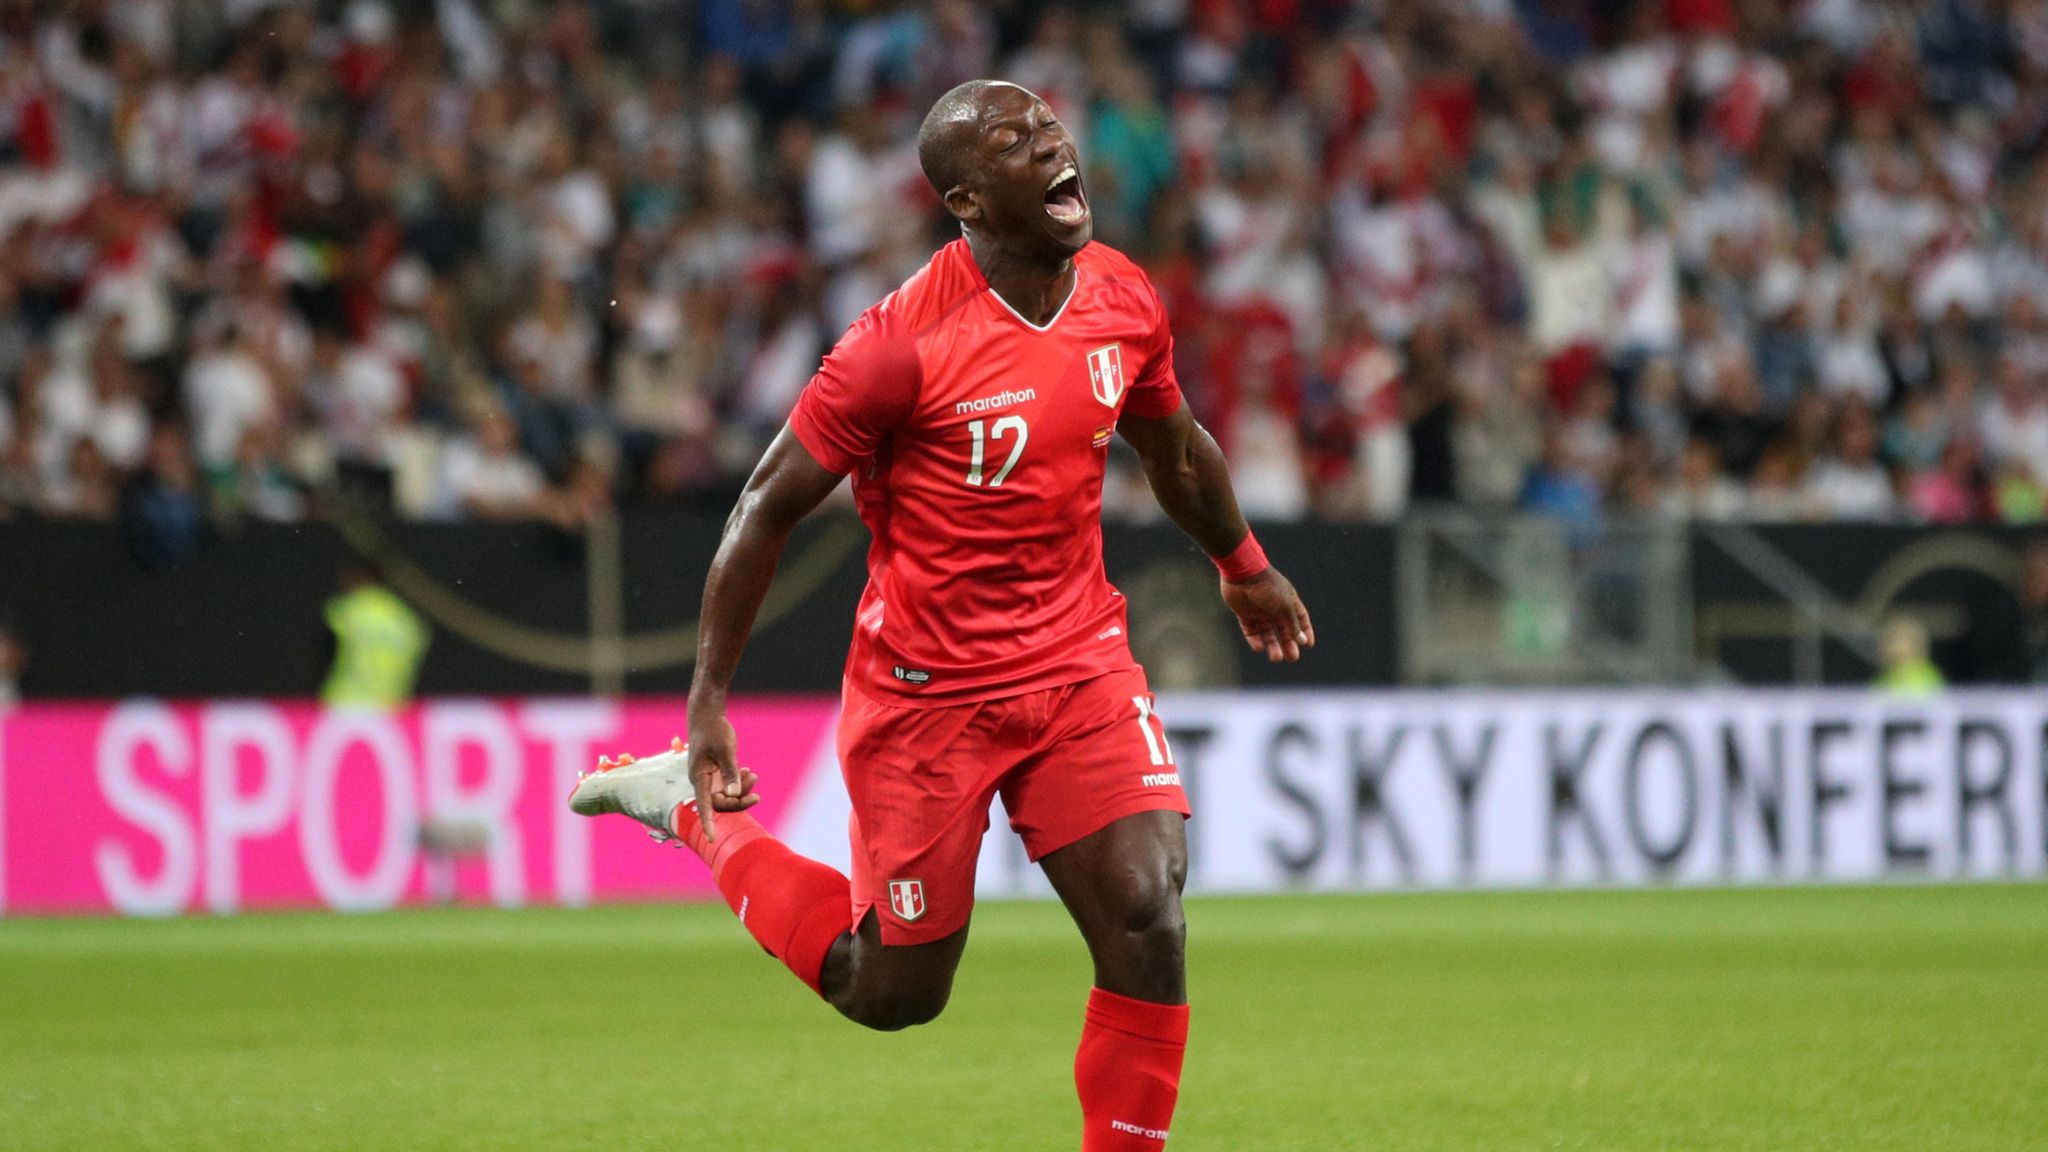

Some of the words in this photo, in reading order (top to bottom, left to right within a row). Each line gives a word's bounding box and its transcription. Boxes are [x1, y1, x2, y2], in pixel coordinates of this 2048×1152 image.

[956, 388, 1036, 415] marathon
[96, 700, 617, 915] SPORT
[1264, 720, 1498, 876] SKY
[1544, 718, 2048, 873] KONFER
